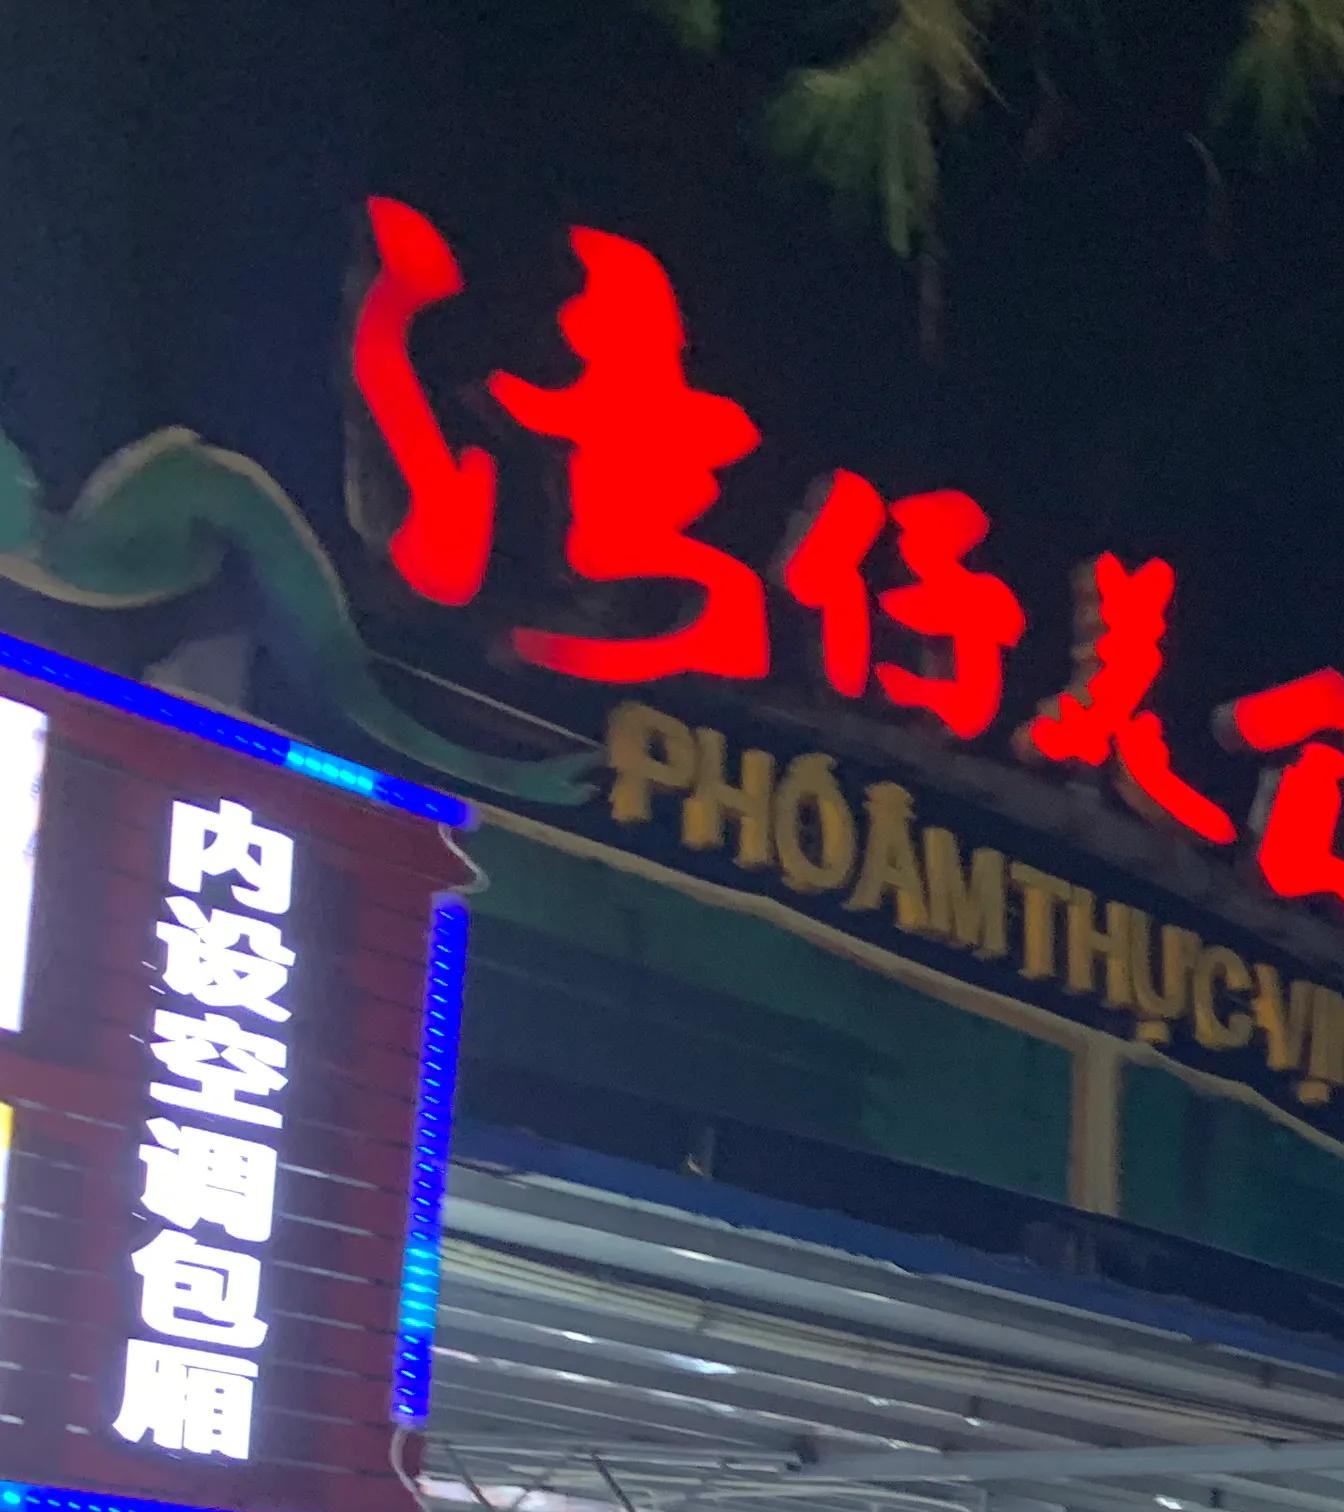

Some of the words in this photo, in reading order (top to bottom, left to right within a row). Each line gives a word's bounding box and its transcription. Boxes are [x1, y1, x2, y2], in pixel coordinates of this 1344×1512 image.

[112, 797, 297, 1461] 内设空调包厢
